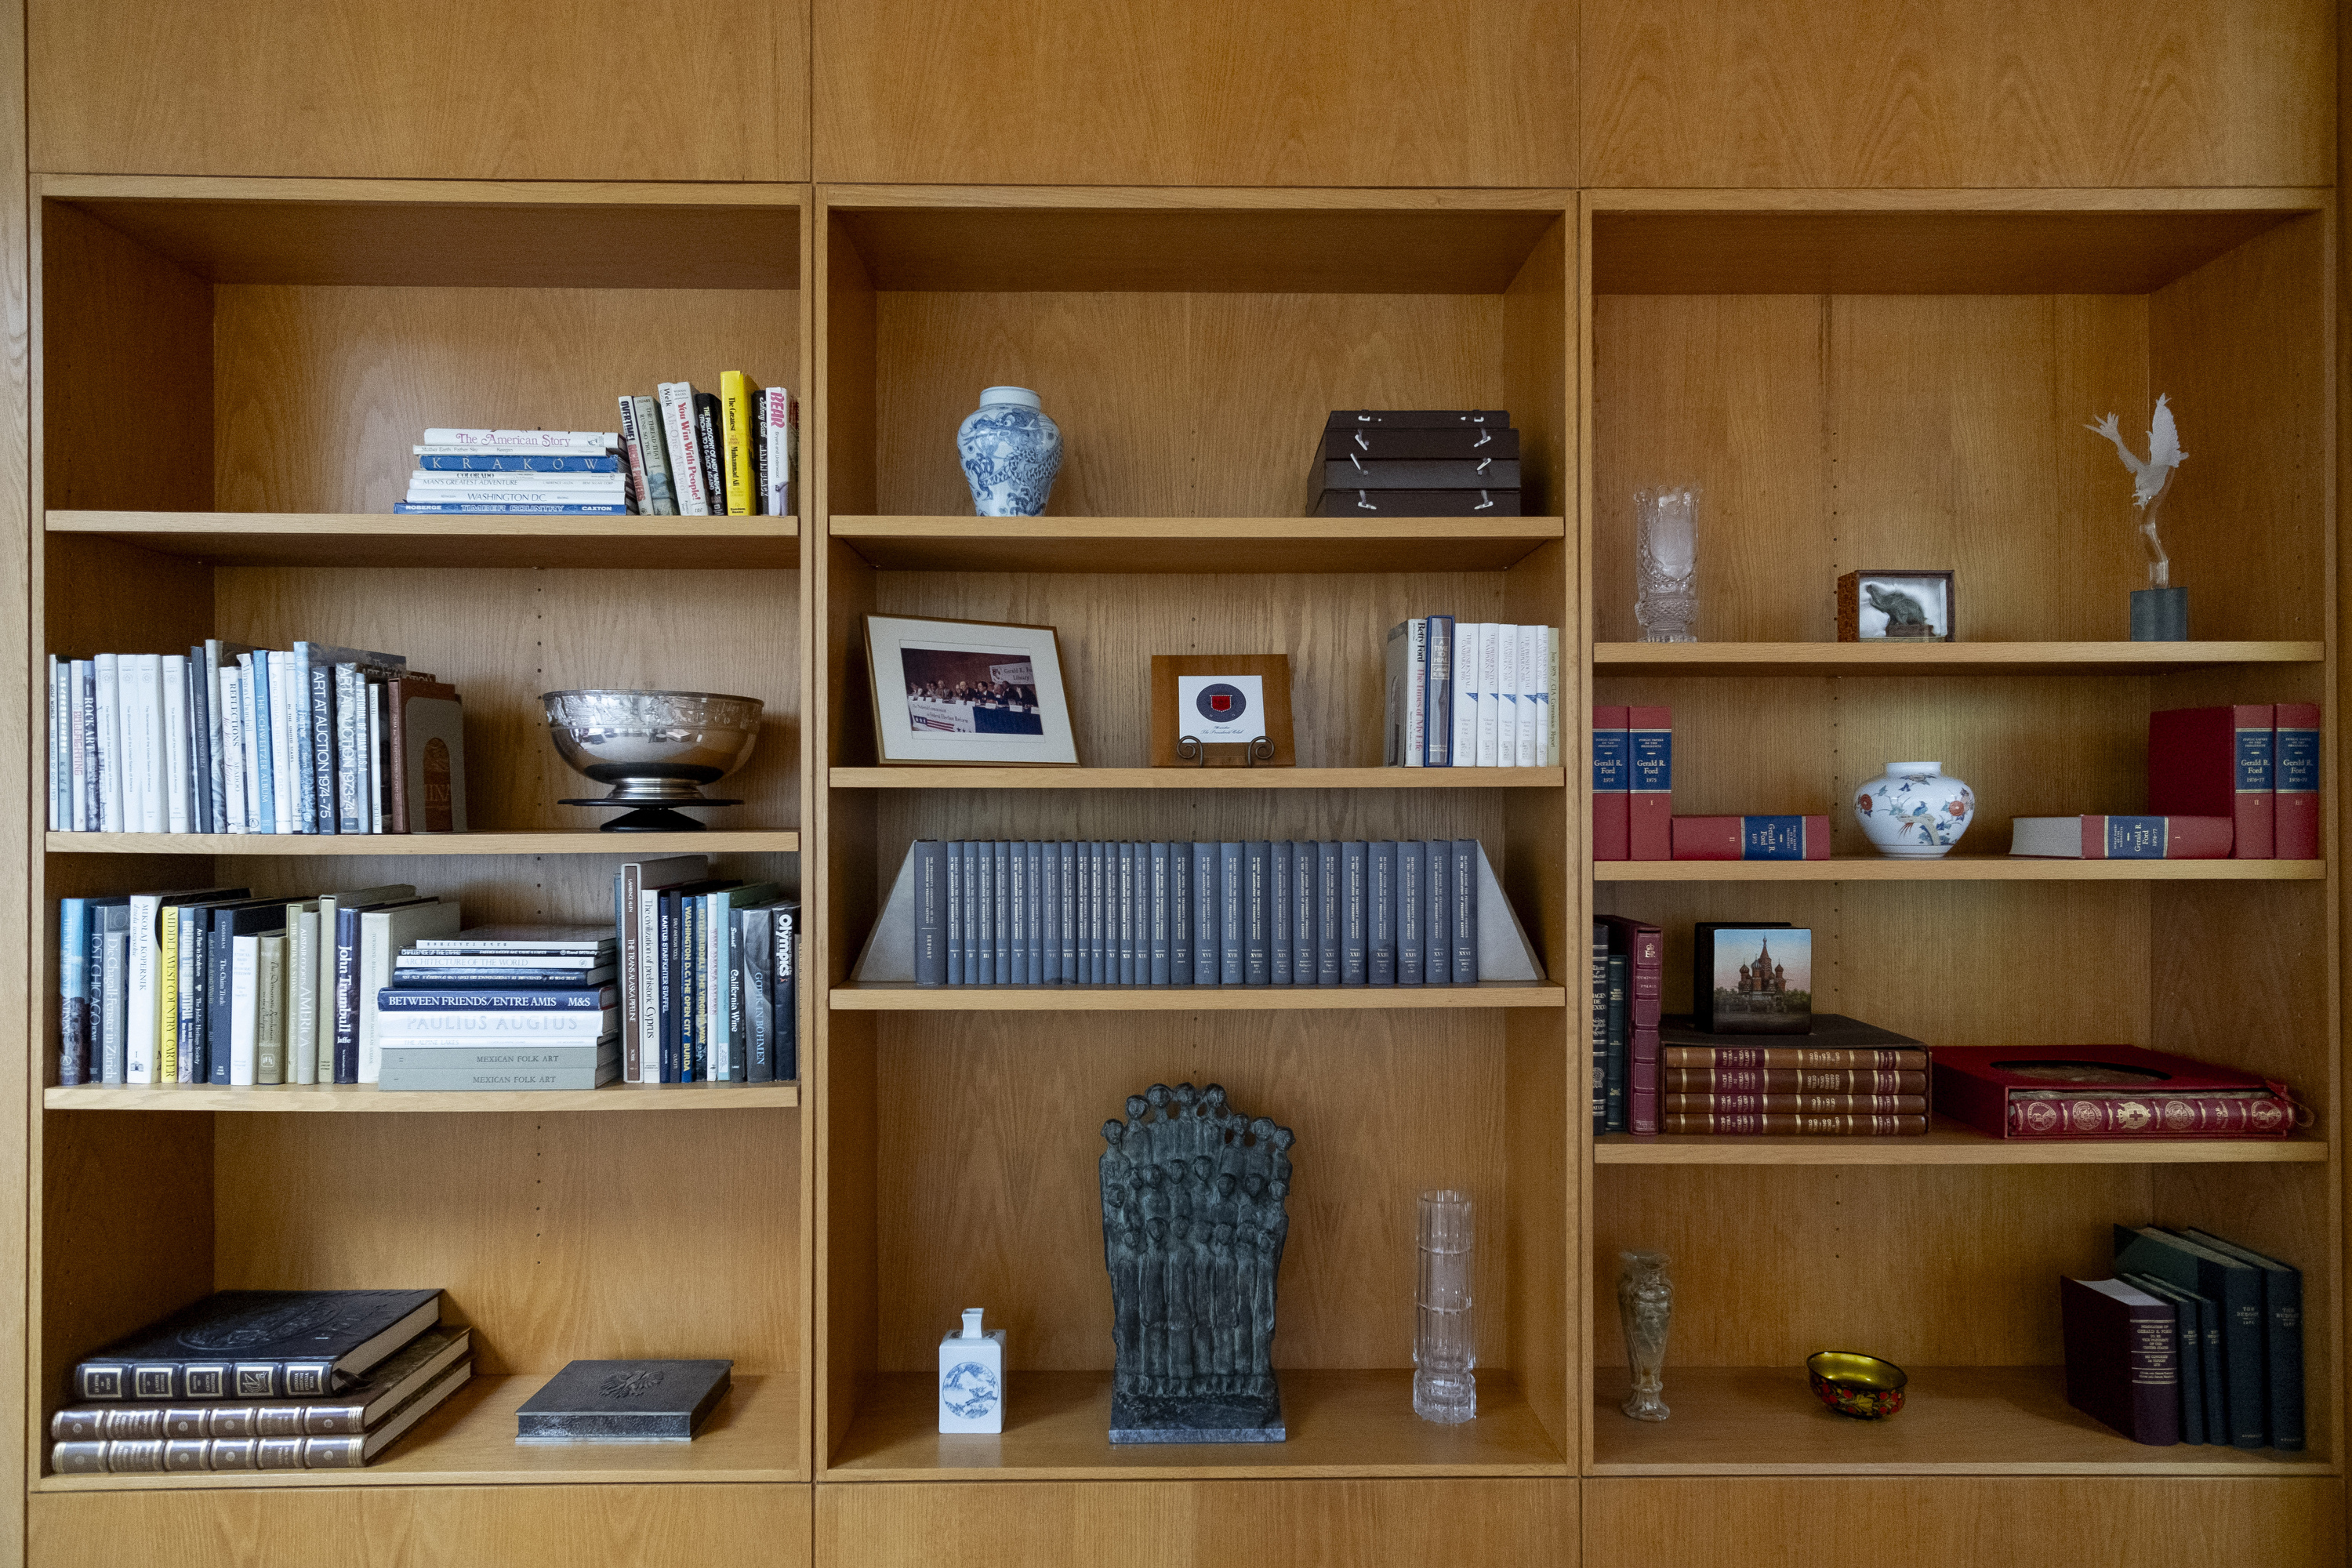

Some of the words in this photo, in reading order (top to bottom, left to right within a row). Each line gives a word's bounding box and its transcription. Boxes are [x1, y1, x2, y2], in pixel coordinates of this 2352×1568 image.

[664, 388, 672, 407] Welk
[678, 402, 687, 420] You
[770, 392, 785, 429] BEAR
[456, 433, 477, 444] The
[481, 434, 538, 445] American
[542, 434, 571, 447] Story
[681, 421, 690, 441] Win
[433, 457, 597, 470] KRAKÓW
[684, 441, 695, 465] With
[688, 466, 701, 501] People!
[1417, 622, 1426, 642] Betty
[242, 663, 251, 695] Winston
[314, 671, 326, 698] ART
[339, 667, 352, 694] ART
[85, 697, 94, 726] ROCK
[244, 696, 253, 732] Churchill
[316, 699, 327, 714] AT
[341, 695, 353, 712] AT
[356, 689, 366, 721] PICTORIAL
[357, 722, 366, 731] OF
[1415, 718, 1423, 732] My
[73, 711, 83, 776] BULLFIGHTING
[85, 731, 96, 753] ART
[258, 714, 268, 770] SCHWEITZER
[316, 715, 329, 771] AUCTION
[342, 713, 355, 769] AUCTION
[357, 731, 367, 752] GUAM
[1415, 733, 1423, 751] Life
[260, 773, 269, 803] ALBUM
[343, 772, 356, 812] 1973-74
[644, 899, 652, 915] The
[107, 938, 118, 955] Die
[167, 912, 176, 955] MIDDLE
[775, 913, 793, 977] Olympics
[92, 933, 102, 964] LOST
[338, 946, 352, 974] John
[405, 958, 466, 966] ARCHITECTURE
[645, 956, 652, 964] of
[139, 946, 148, 991] KOPERNIK
[166, 956, 175, 985] WEST
[90, 964, 102, 1025] CHICAGO
[644, 966, 653, 1004] prehistoric
[730, 969, 740, 1014] California
[755, 972, 764, 1004] GOTIK
[165, 985, 175, 1033] COUNTRY
[338, 975, 352, 1033] Trumbull
[389, 996, 440, 1006] BETWEEN
[442, 996, 529, 1006] FRIENDS/ENTRE
[531, 997, 556, 1006] AMIS
[568, 997, 590, 1006] M&S
[756, 1007, 764, 1017] IN
[407, 1015, 487, 1030] PAULIUS
[496, 1016, 577, 1030] AUGIUS
[646, 1007, 656, 1038] Cyprus
[731, 1014, 740, 1033] Wine
[107, 1033, 117, 1044] in
[757, 1019, 765, 1065] BÖHMEN
[105, 1045, 118, 1079] Zürich
[165, 1039, 174, 1078] CARTER
